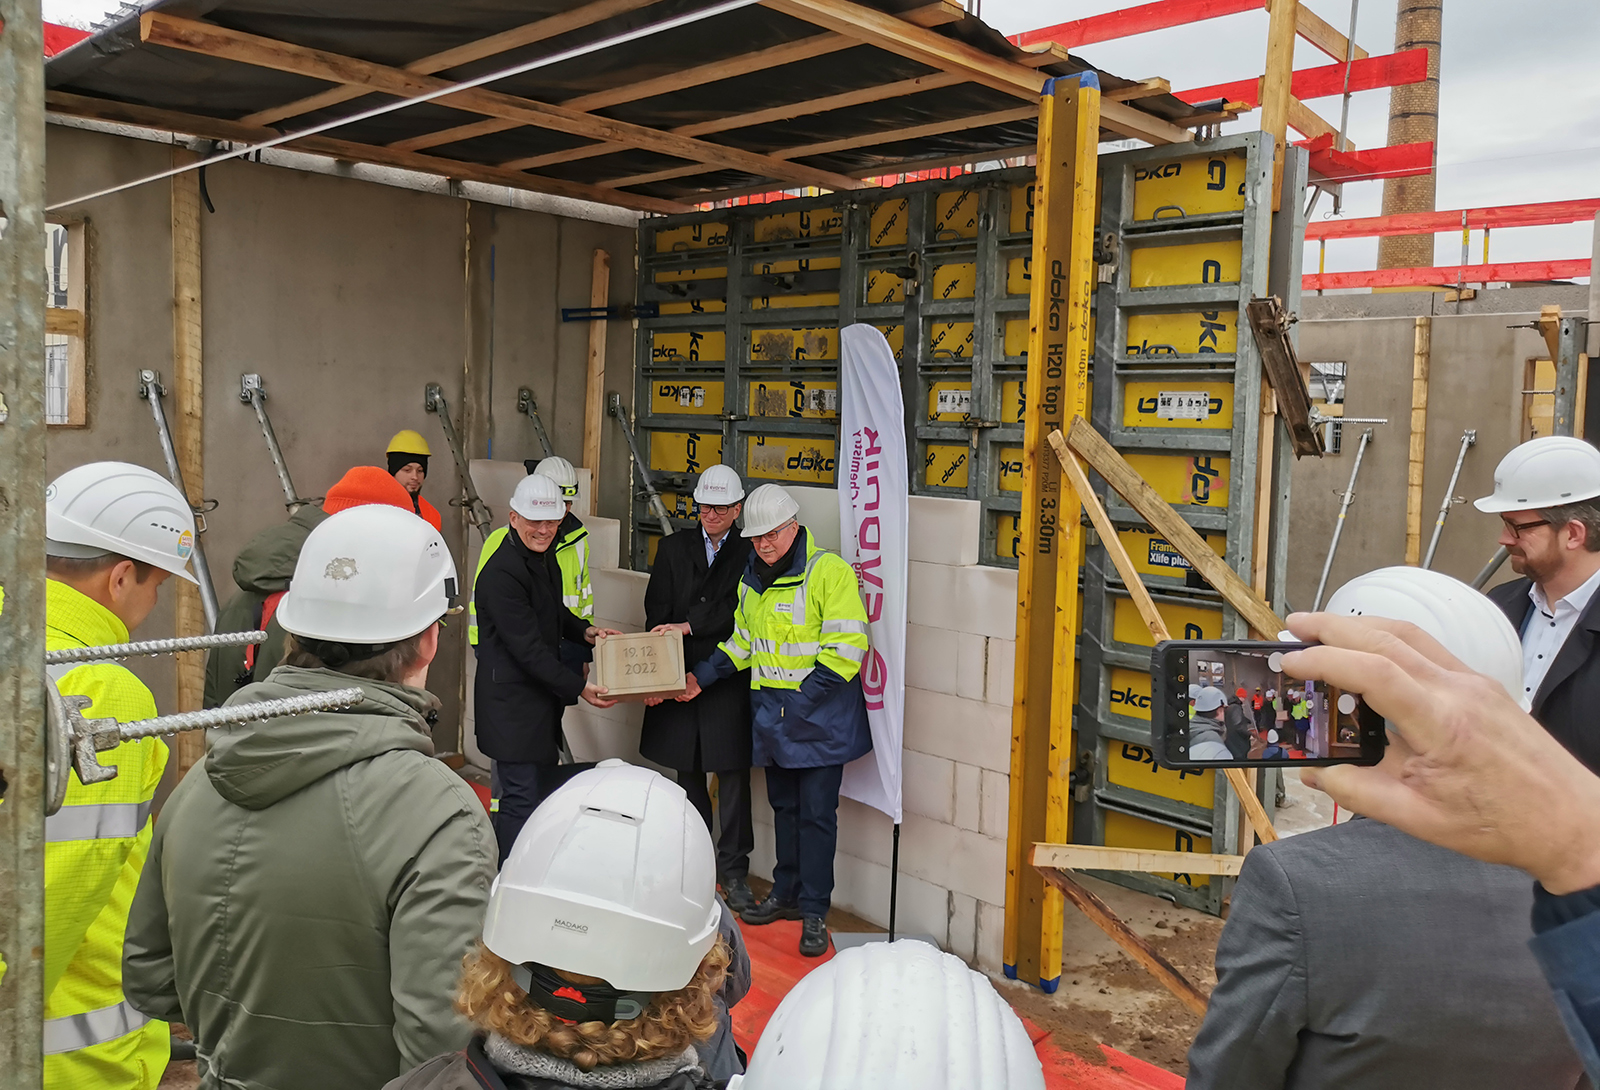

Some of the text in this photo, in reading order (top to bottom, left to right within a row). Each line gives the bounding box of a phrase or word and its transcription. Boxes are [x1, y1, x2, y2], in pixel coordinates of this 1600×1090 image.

[1048, 260, 1066, 332] doka
[1081, 281, 1090, 341] doka
[1045, 343, 1063, 379] H20
[1042, 385, 1061, 415] top
[941, 453, 966, 483] doka
[1038, 498, 1057, 554] 3.30m
[1150, 553, 1170, 564] Xlife
[624, 662, 657, 675] 2022
[554, 919, 589, 932] MADAKO
